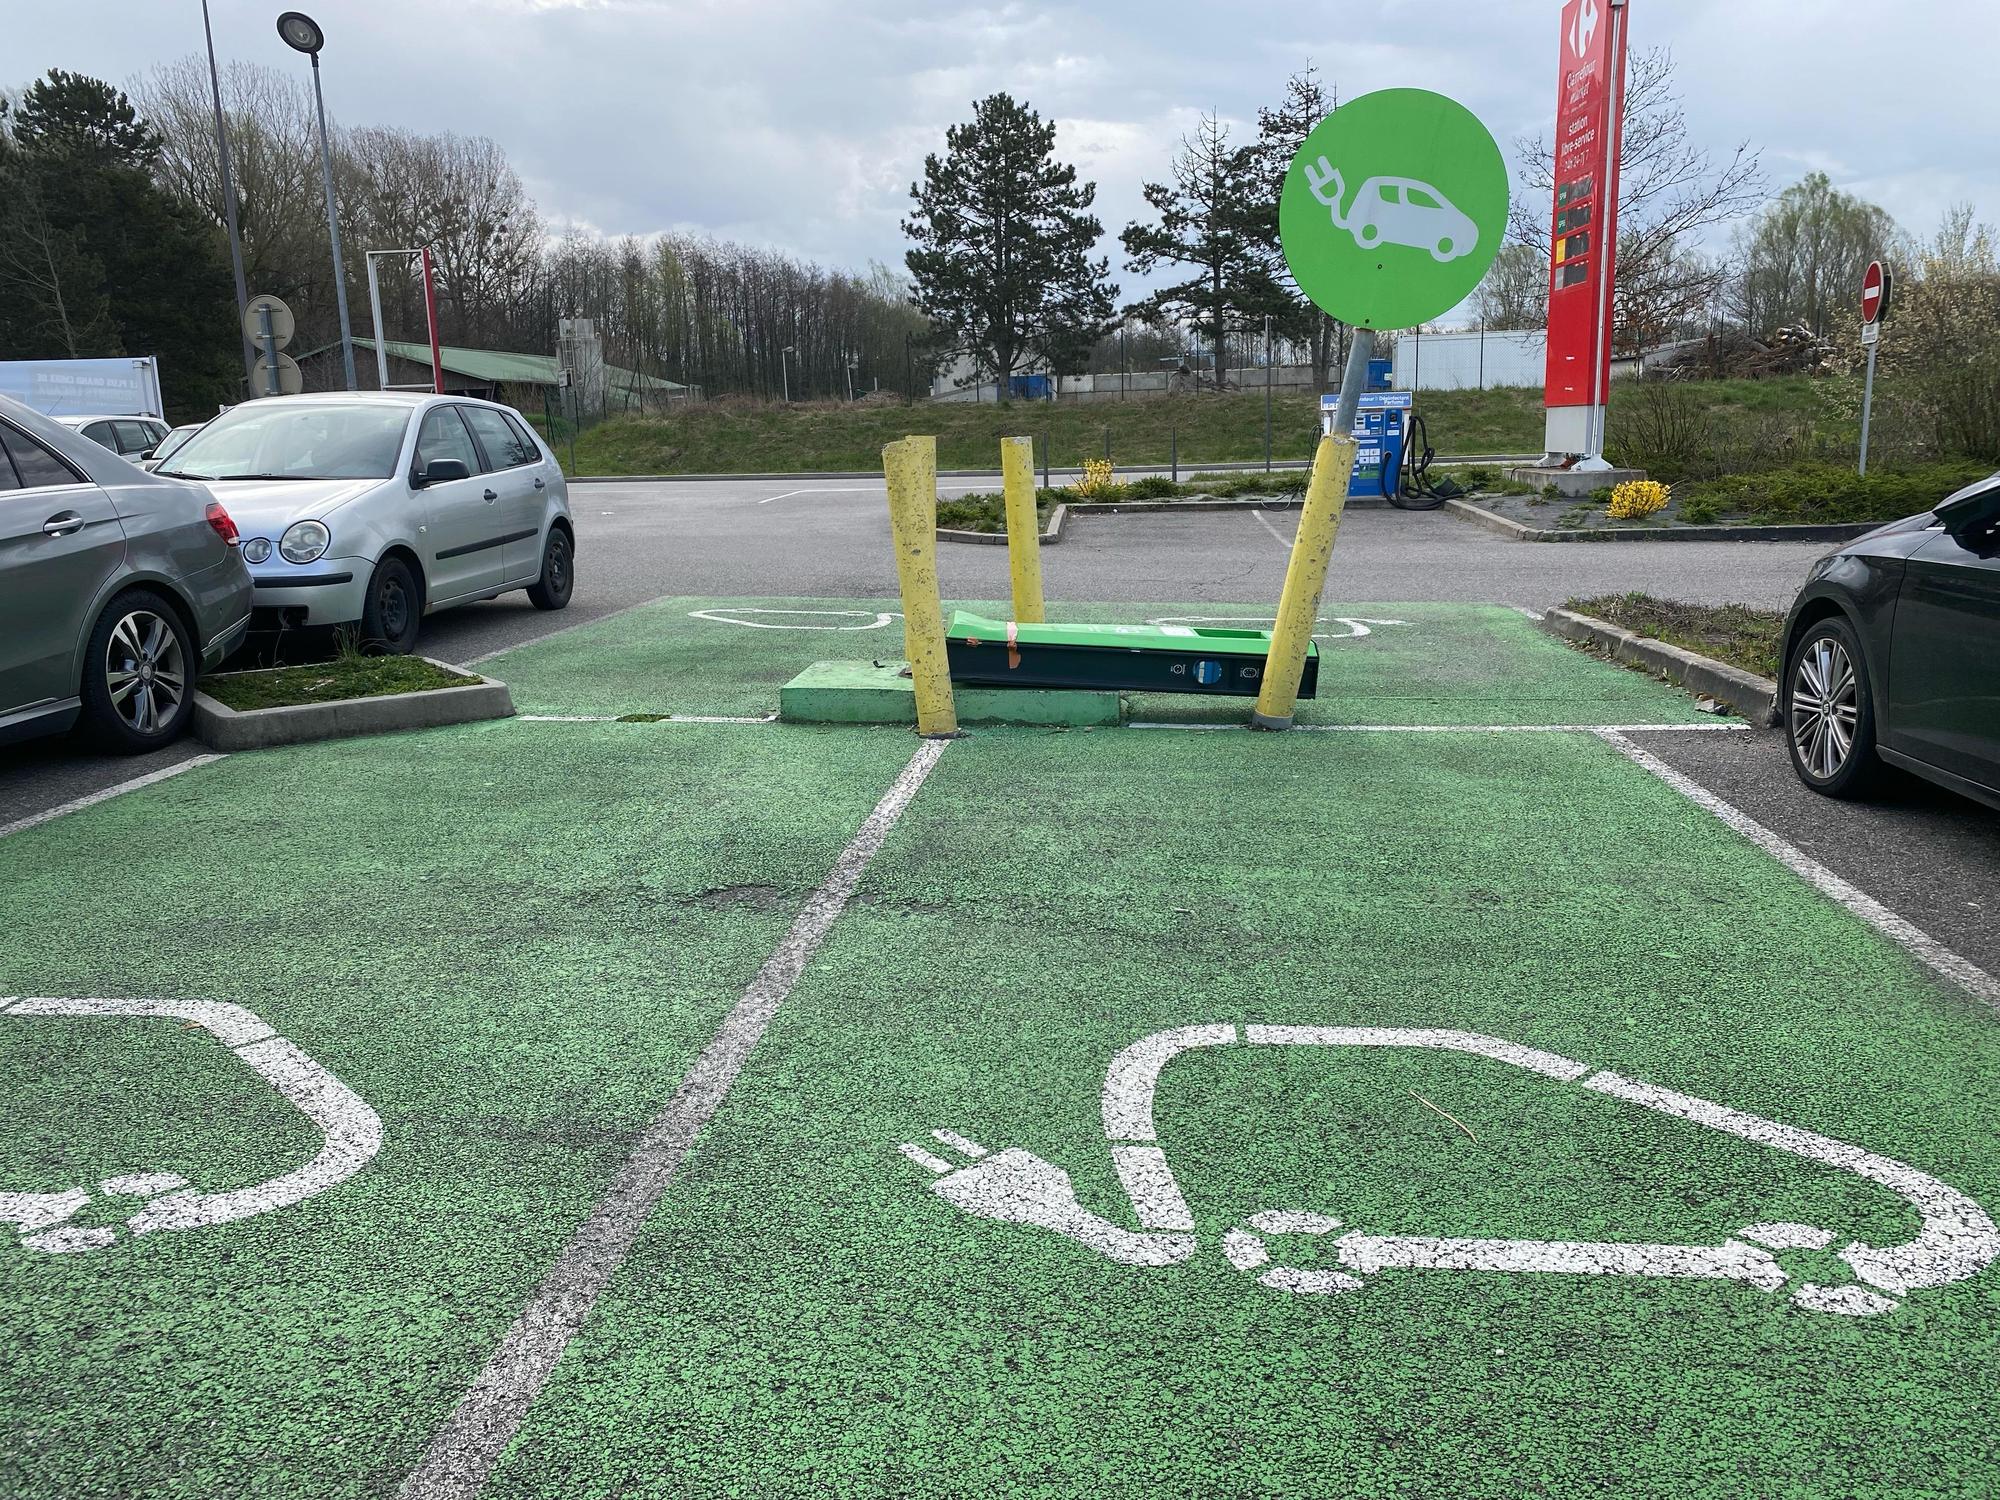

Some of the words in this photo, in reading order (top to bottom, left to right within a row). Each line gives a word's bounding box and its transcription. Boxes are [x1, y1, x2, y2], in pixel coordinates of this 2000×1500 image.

[1566, 59, 1597, 89] Carrefour
[1568, 115, 1588, 136] station
[1561, 128, 1596, 158] libre-service
